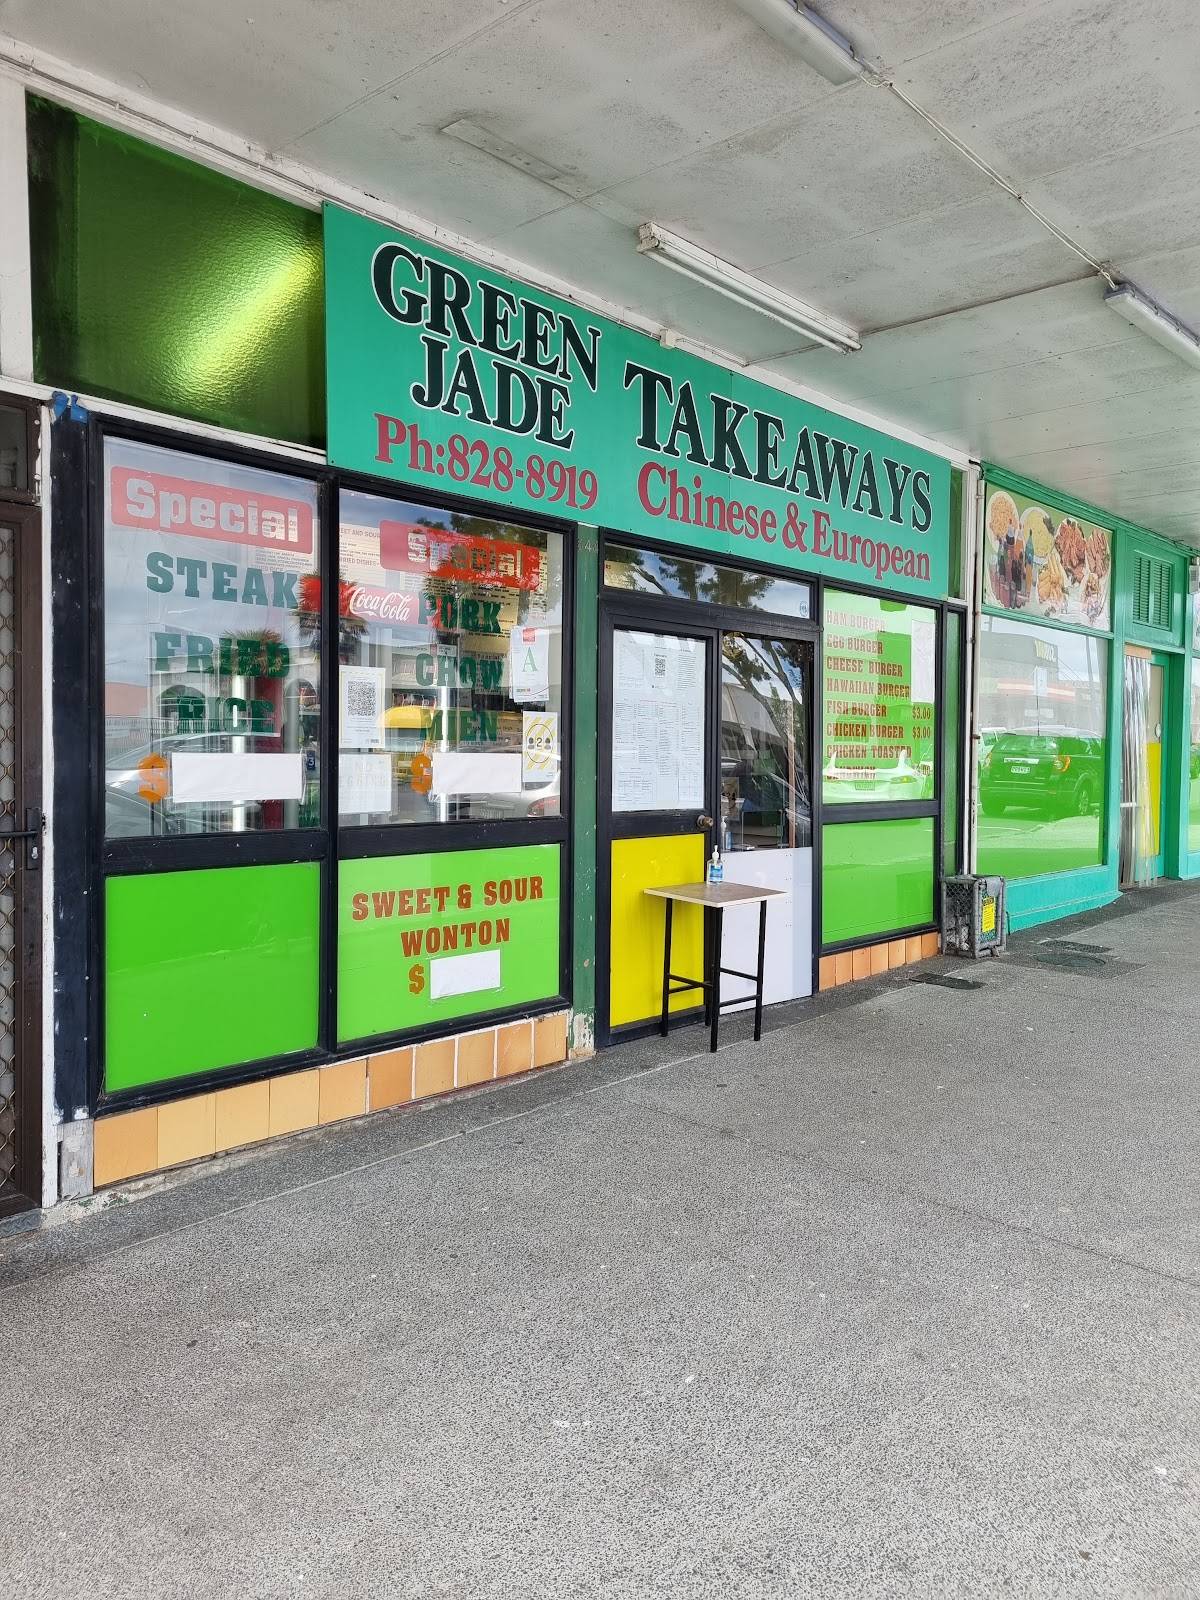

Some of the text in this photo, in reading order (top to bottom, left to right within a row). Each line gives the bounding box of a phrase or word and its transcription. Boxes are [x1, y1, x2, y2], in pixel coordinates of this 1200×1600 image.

[371, 241, 602, 392] GREEN
[410, 334, 574, 450] JADE
[374, 412, 598, 511] Ph:828-8919
[623, 361, 931, 533] TAKEAWAYS
[126, 478, 299, 543] Special
[637, 461, 931, 581] Chinese & European
[408, 529, 522, 578] Special
[146, 552, 299, 608] STEAK
[418, 591, 501, 633] PORK
[827, 610, 886, 633] HAM BURGER
[154, 632, 290, 679] FRIED
[522, 646, 538, 673] A
[827, 633, 883, 654] EGG BURGER
[415, 653, 505, 689] CHOW
[826, 656, 903, 678] CHEESE BURGER
[826, 677, 910, 698] HAWAIIAN BURGER
[177, 696, 275, 734] RICE
[420, 709, 499, 742] MIEN
[827, 699, 931, 720] FISH BURGER $3.00
[536, 737, 543, 748] 2
[827, 722, 931, 740] CHICKEN BURGER $3.00
[827, 743, 912, 760] CHICKEN TOASTED
[352, 875, 543, 921] SWEET & SOUR
[400, 917, 511, 958] WONTON
[408, 963, 426, 995] $
